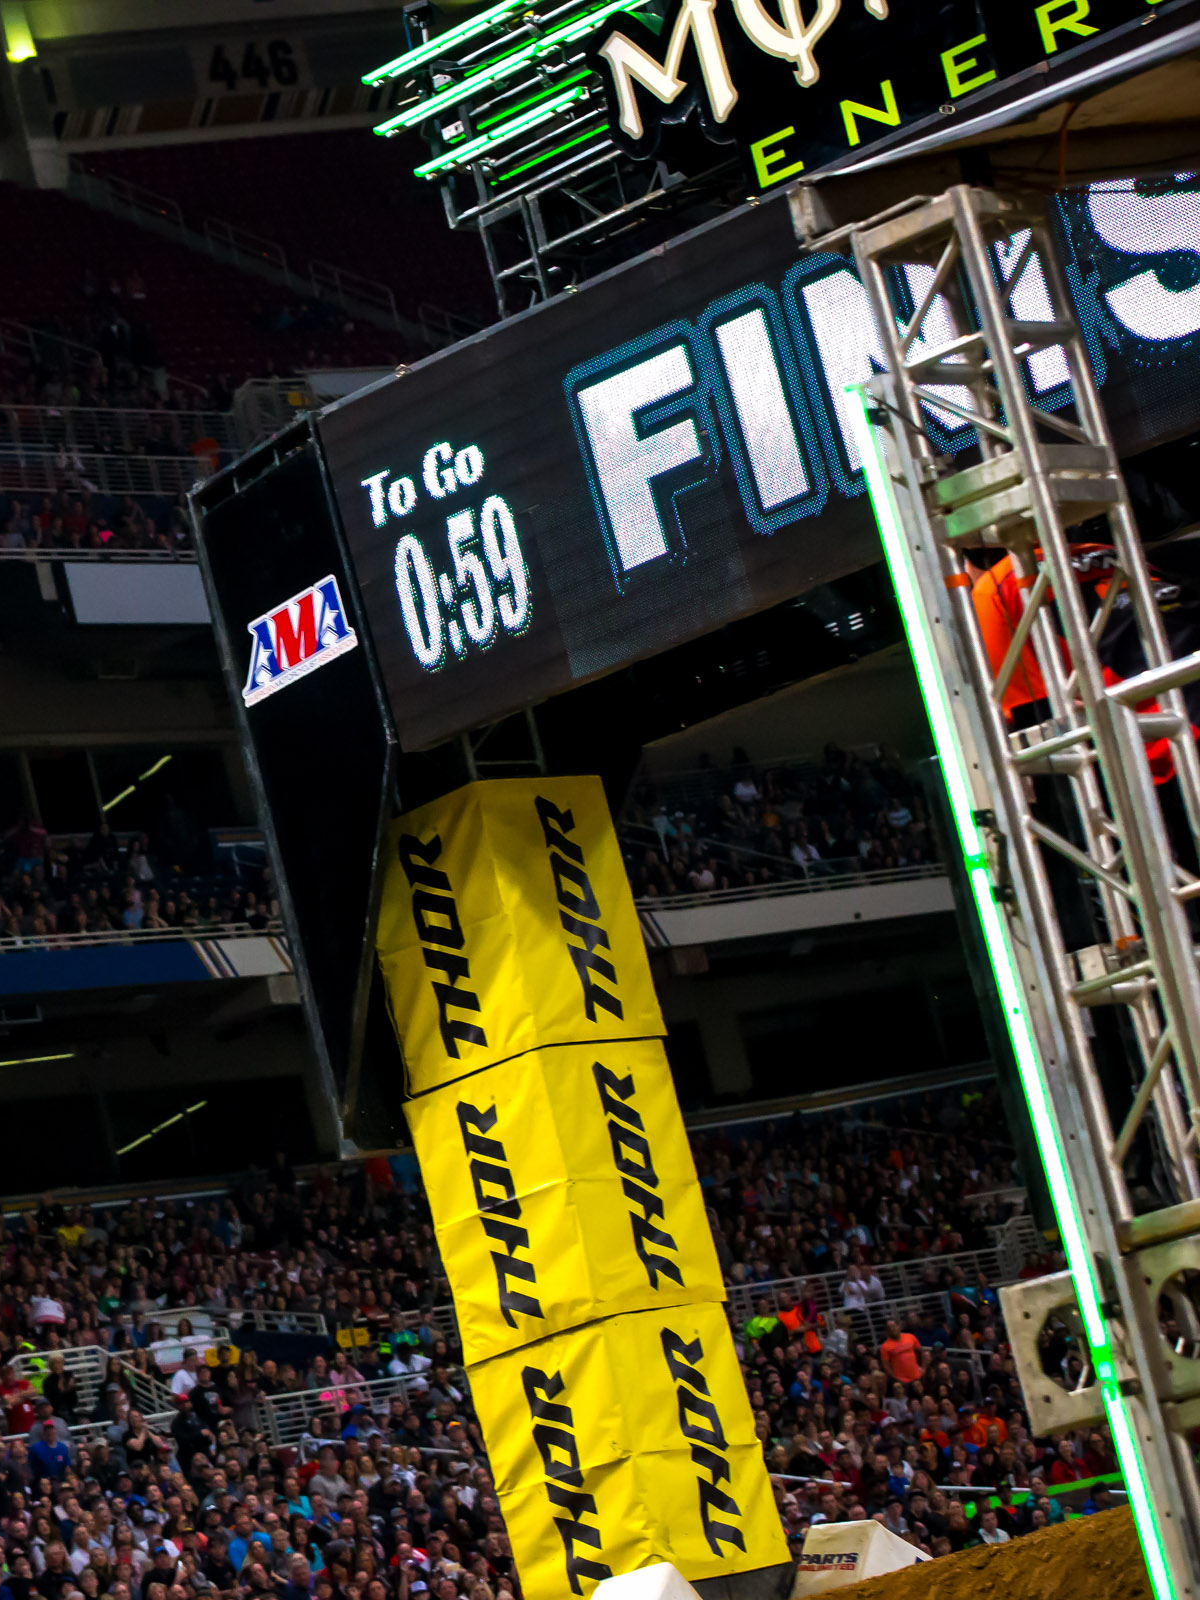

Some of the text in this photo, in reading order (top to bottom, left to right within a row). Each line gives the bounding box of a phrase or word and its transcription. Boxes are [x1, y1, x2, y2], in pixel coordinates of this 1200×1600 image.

[210, 40, 297, 90] 446
[750, 0, 1174, 188] ENER
[360, 441, 486, 528] To Go
[394, 494, 533, 672] 0:59
[247, 578, 353, 692] AMA
[399, 832, 488, 1059] THOR
[535, 795, 624, 1023] THOR
[456, 1100, 544, 1329] THOR
[592, 1061, 685, 1291] THOR
[521, 1365, 613, 1596] THOR
[660, 1327, 747, 1558] THOR
[800, 1552, 859, 1565] PARTS
